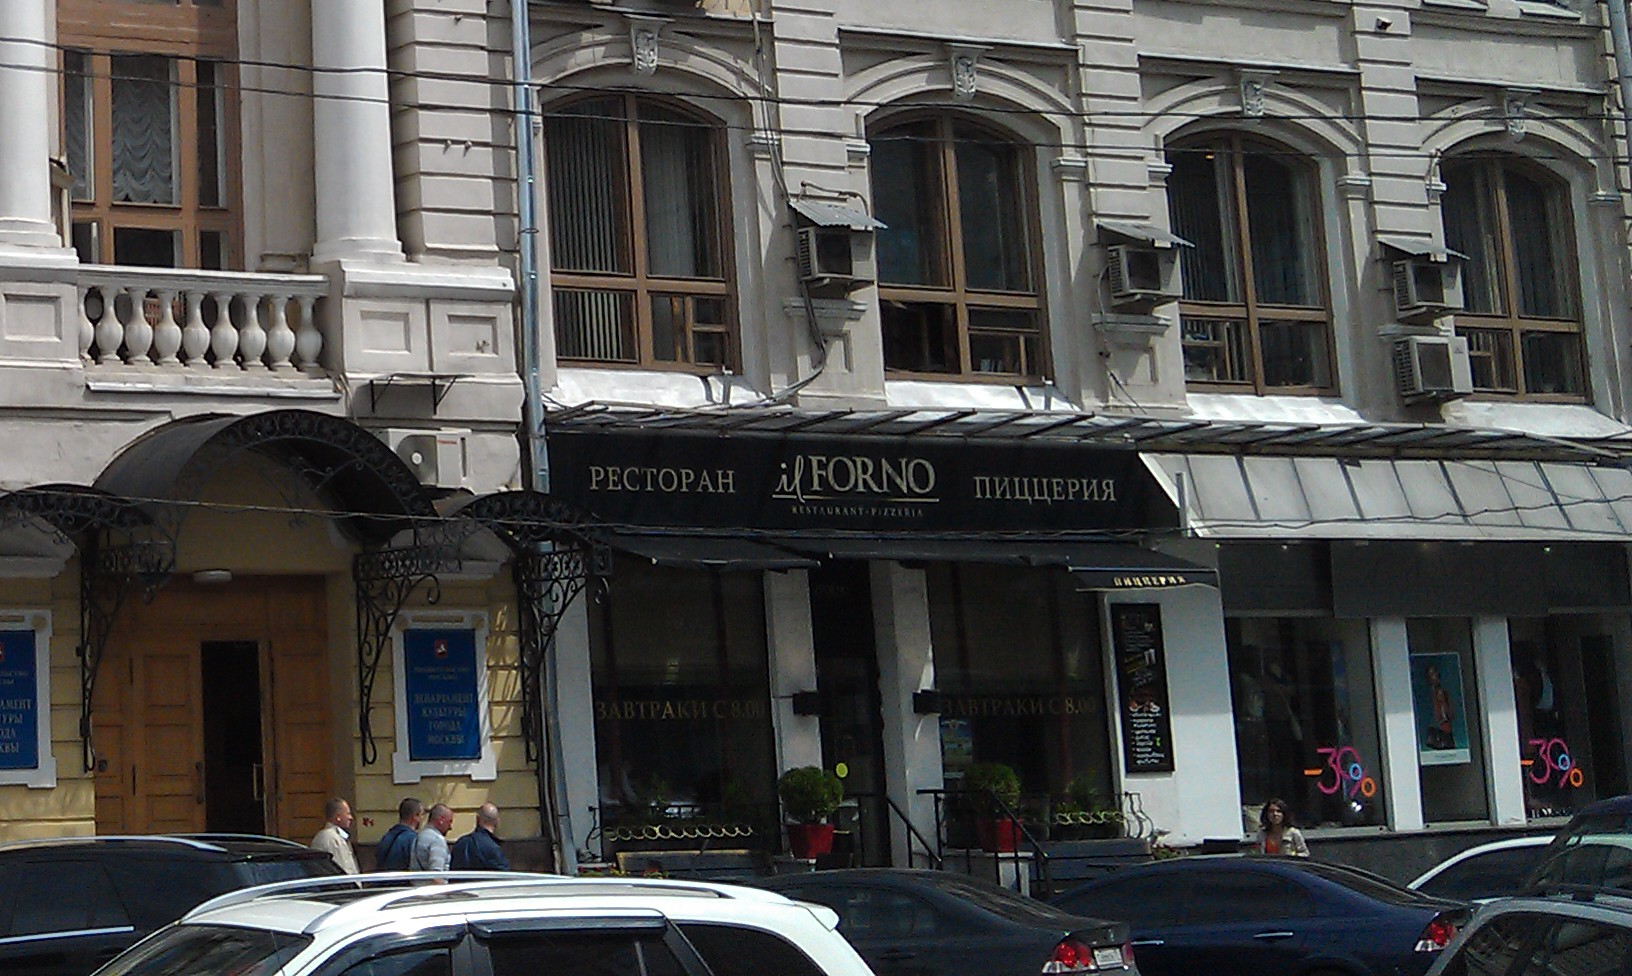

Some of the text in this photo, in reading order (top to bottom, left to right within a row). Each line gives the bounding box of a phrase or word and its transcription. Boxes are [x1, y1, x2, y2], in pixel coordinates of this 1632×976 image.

[589, 466, 736, 493] РЕСТОРАН
[808, 455, 937, 494] FORNO
[973, 476, 1117, 504] ПИЦЦЕРИЯ
[596, 700, 706, 719] ЗАВТРАКИ
[943, 697, 1044, 715] ЗАВТРАКИ
